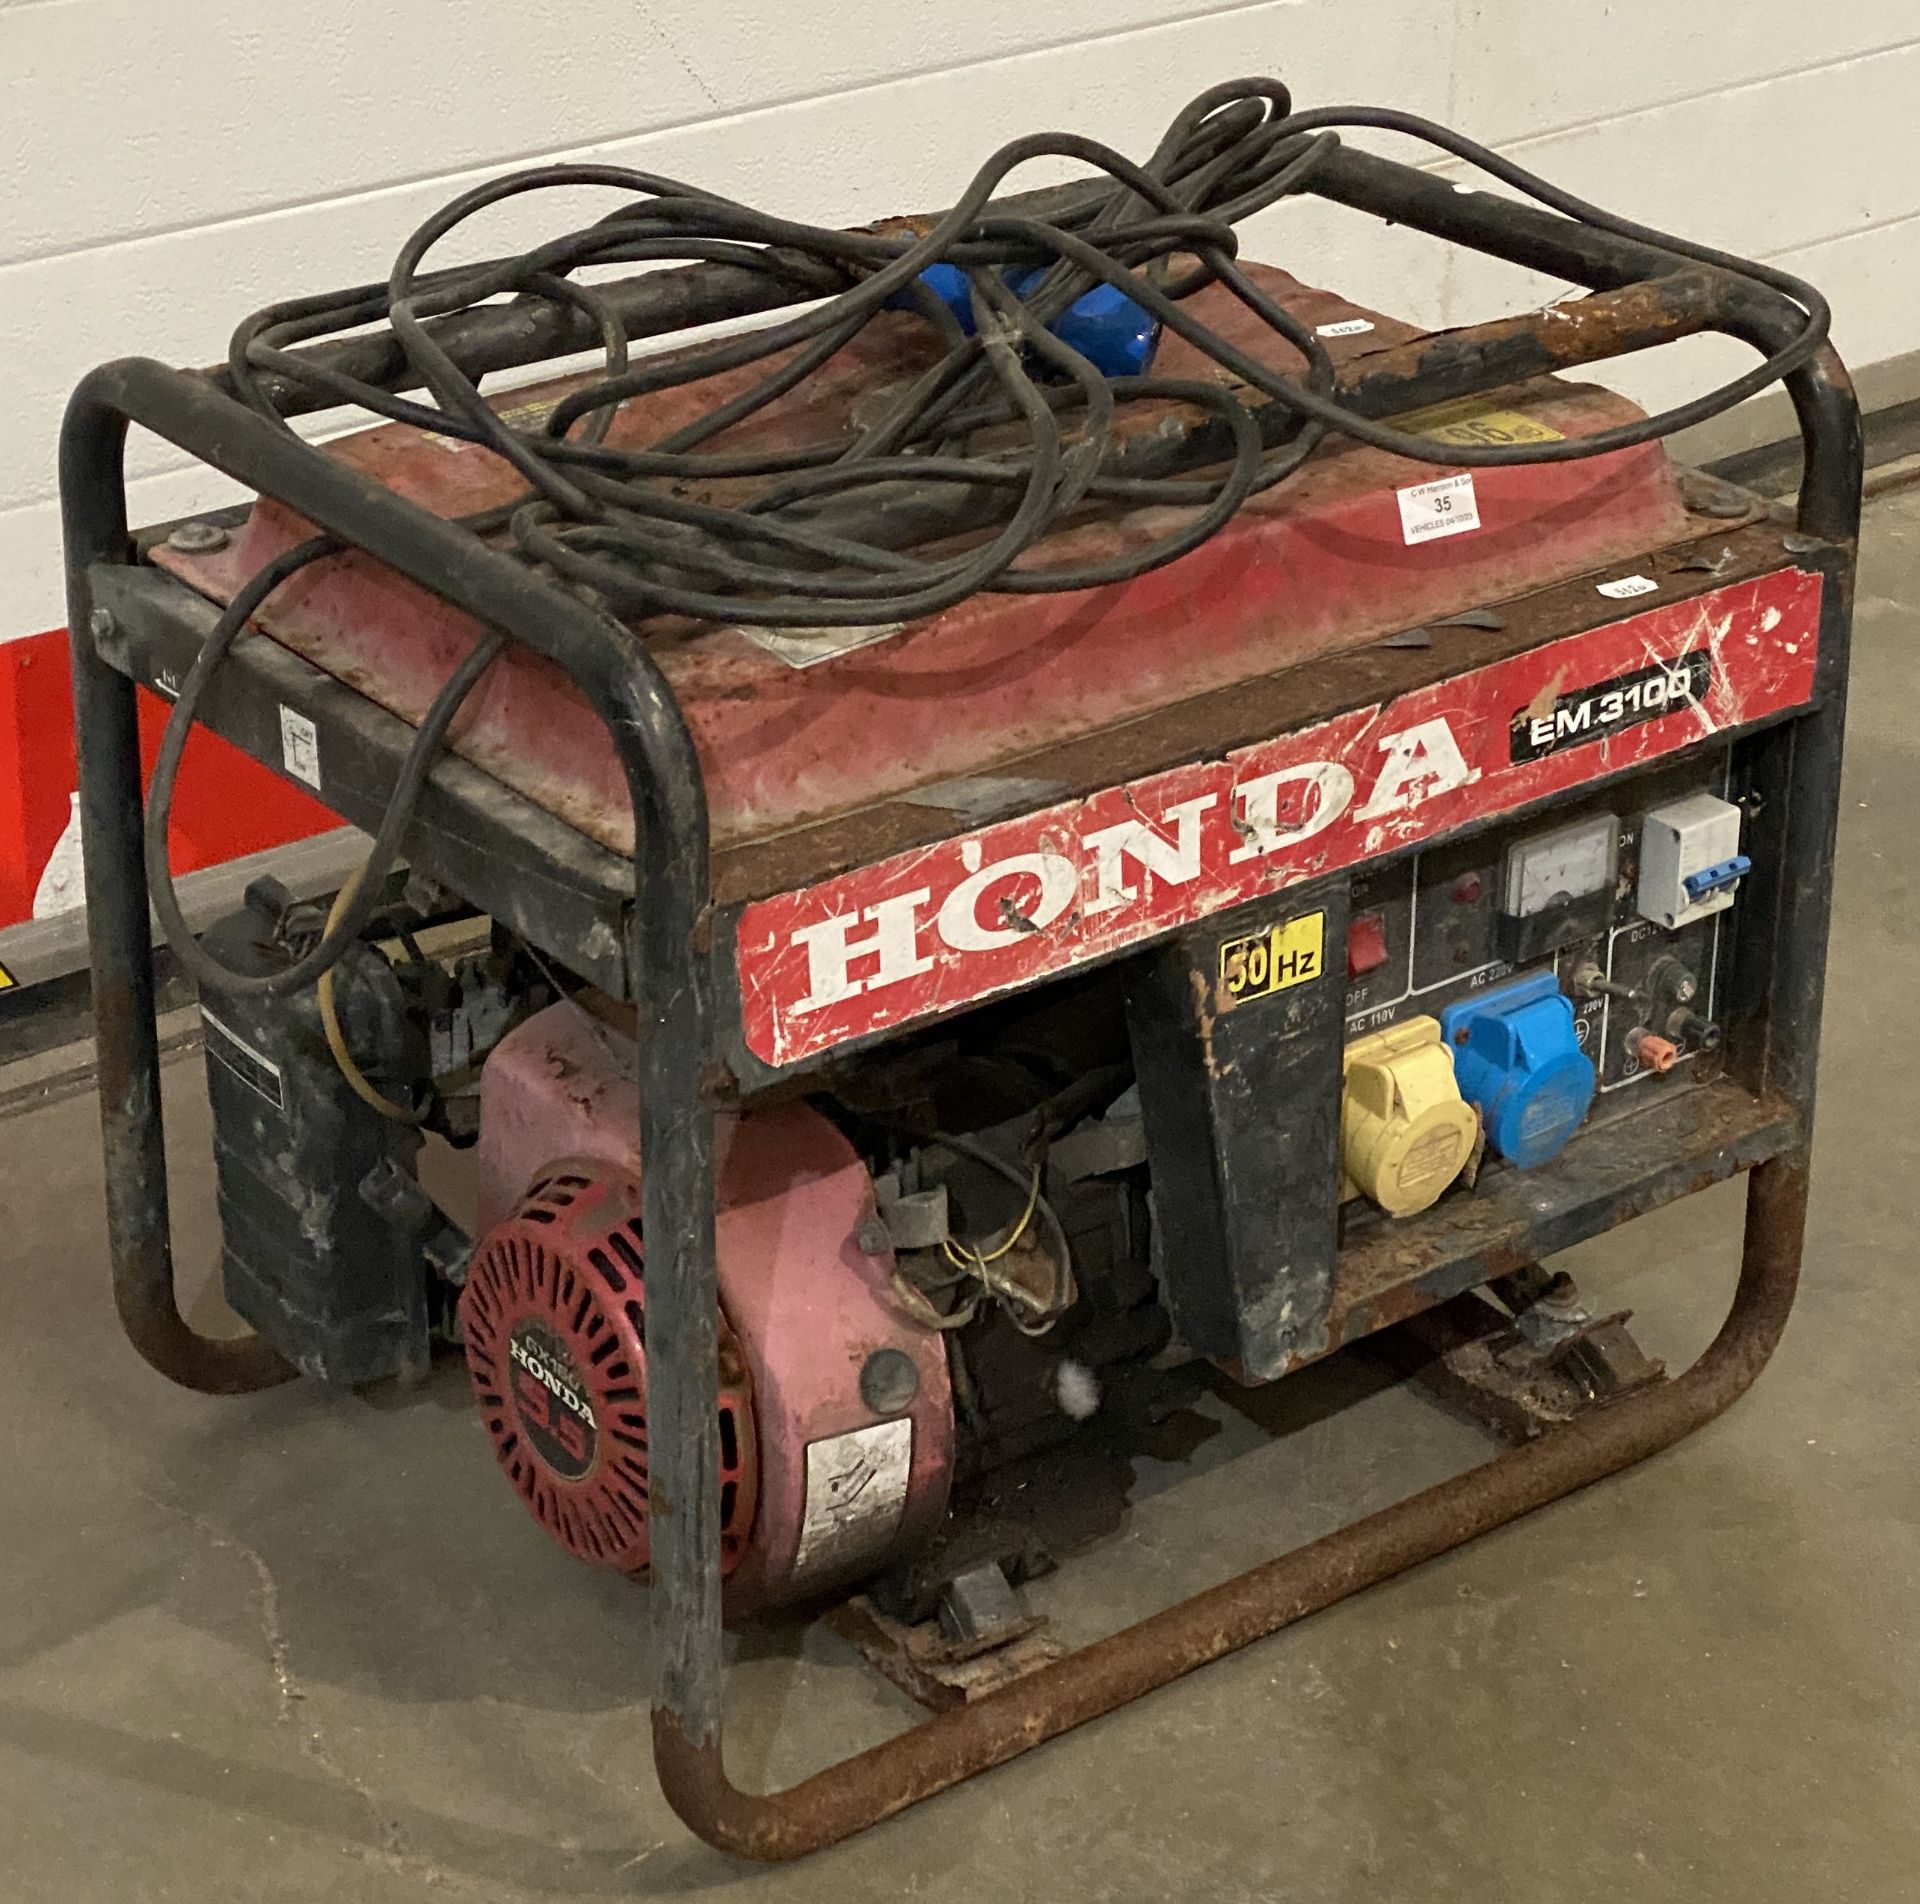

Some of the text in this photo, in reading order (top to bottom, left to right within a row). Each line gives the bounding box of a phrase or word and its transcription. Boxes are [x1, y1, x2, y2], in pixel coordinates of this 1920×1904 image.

[1411, 489, 1418, 498] C
[1419, 486, 1426, 496] W
[1434, 496, 1452, 513] 35
[1411, 519, 1445, 534] VEHICLES
[791, 717, 1482, 1014] HONDA
[1226, 945, 1315, 993] 50 Hz
[1470, 971, 1486, 988] AC
[1346, 987, 1368, 1006] OFF
[1349, 1006, 1396, 1034] AC 110V
[510, 1338, 597, 1430] HONDA
